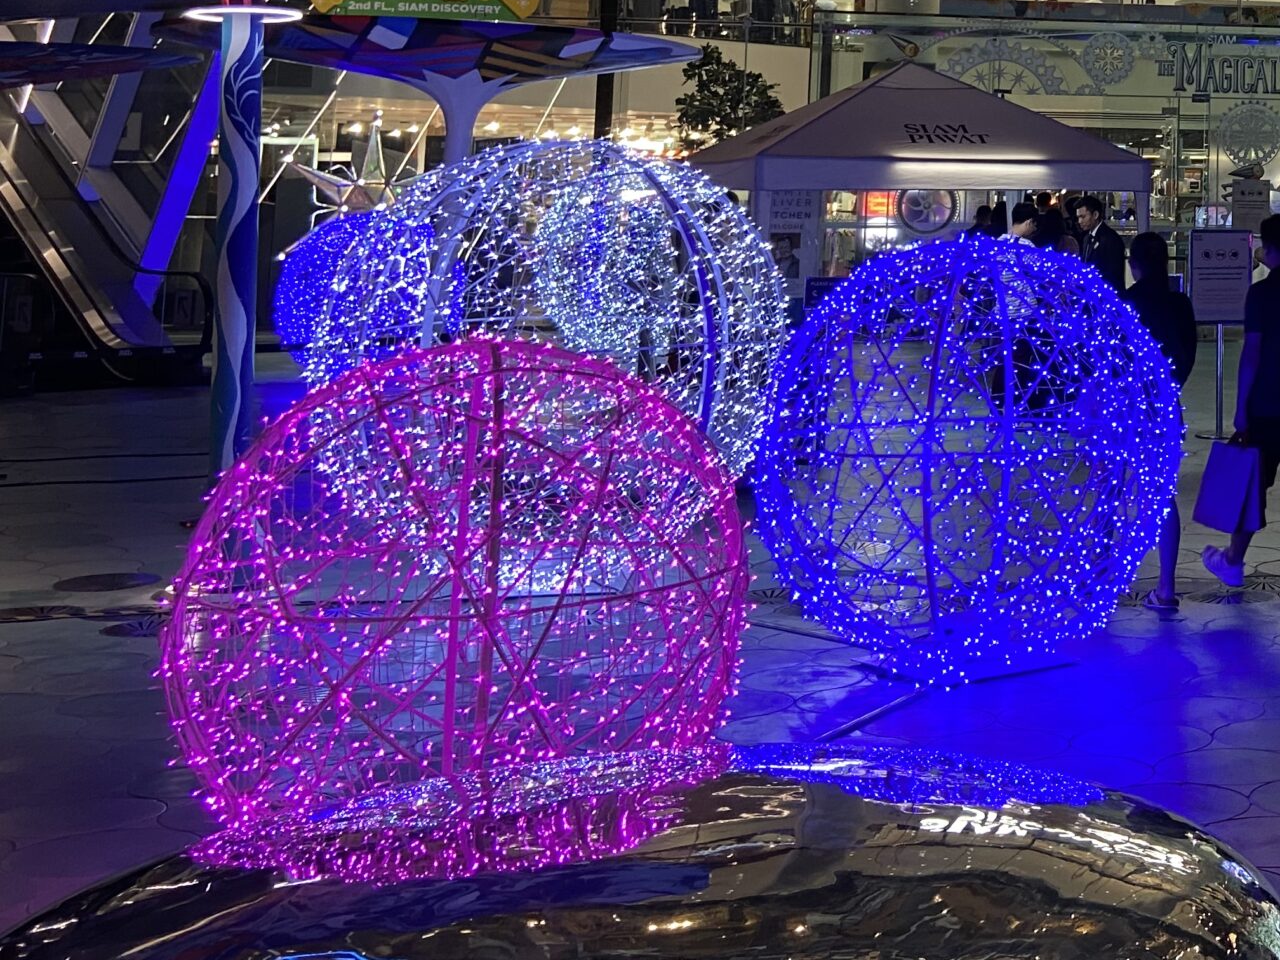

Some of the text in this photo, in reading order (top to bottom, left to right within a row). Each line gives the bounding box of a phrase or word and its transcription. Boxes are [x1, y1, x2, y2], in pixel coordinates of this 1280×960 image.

[348, 0, 371, 12] 2nd
[398, 2, 429, 14] SIAM
[430, 3, 502, 16] DISCOVERY
[1207, 34, 1237, 45] SIAM
[1154, 59, 1175, 77] THE
[904, 124, 969, 134] SIAM
[908, 134, 991, 144] PIWAT
[772, 211, 812, 220] TCHEN
